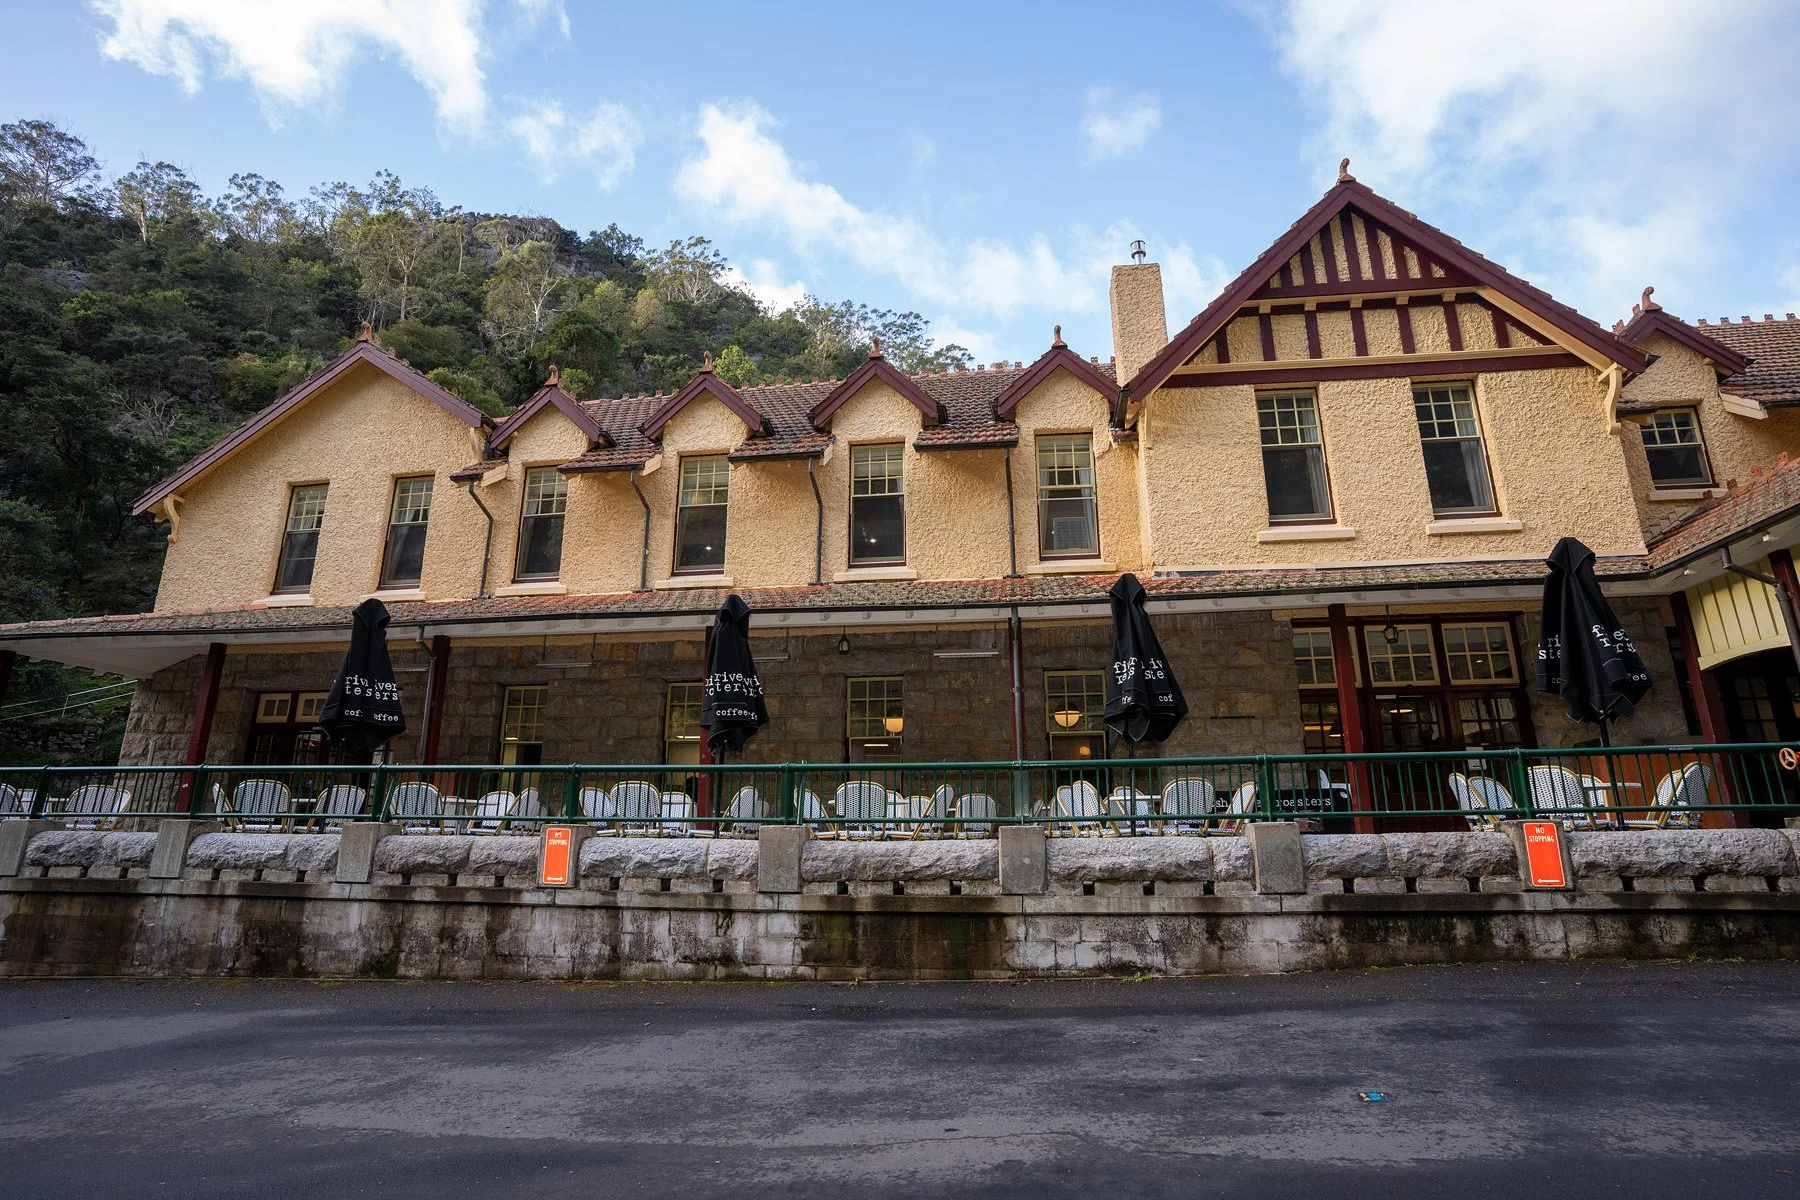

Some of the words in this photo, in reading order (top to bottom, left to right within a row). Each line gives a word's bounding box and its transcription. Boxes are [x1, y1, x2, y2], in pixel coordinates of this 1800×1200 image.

[715, 707, 748, 717] coffee
[1535, 826, 1545, 834] NO
[1528, 835, 1555, 843] STOPPING
